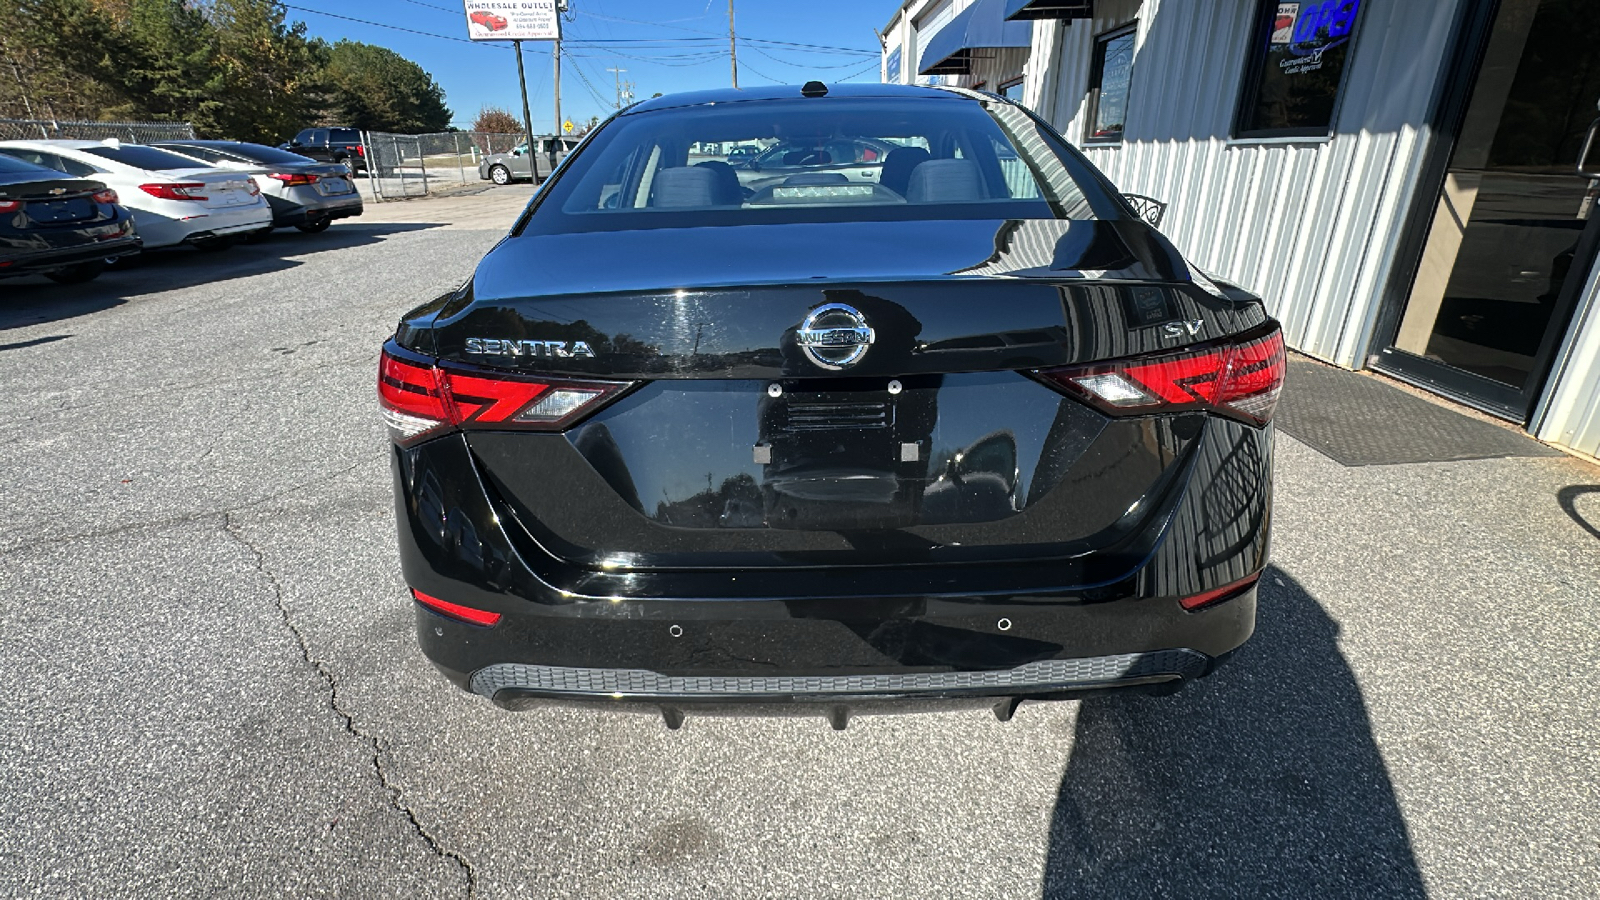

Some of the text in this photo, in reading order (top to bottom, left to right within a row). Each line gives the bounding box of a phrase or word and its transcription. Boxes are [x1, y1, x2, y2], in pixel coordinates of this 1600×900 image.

[804, 330, 868, 345] NISSAN
[1163, 319, 1204, 339] SV
[464, 337, 597, 358] SENTRA
